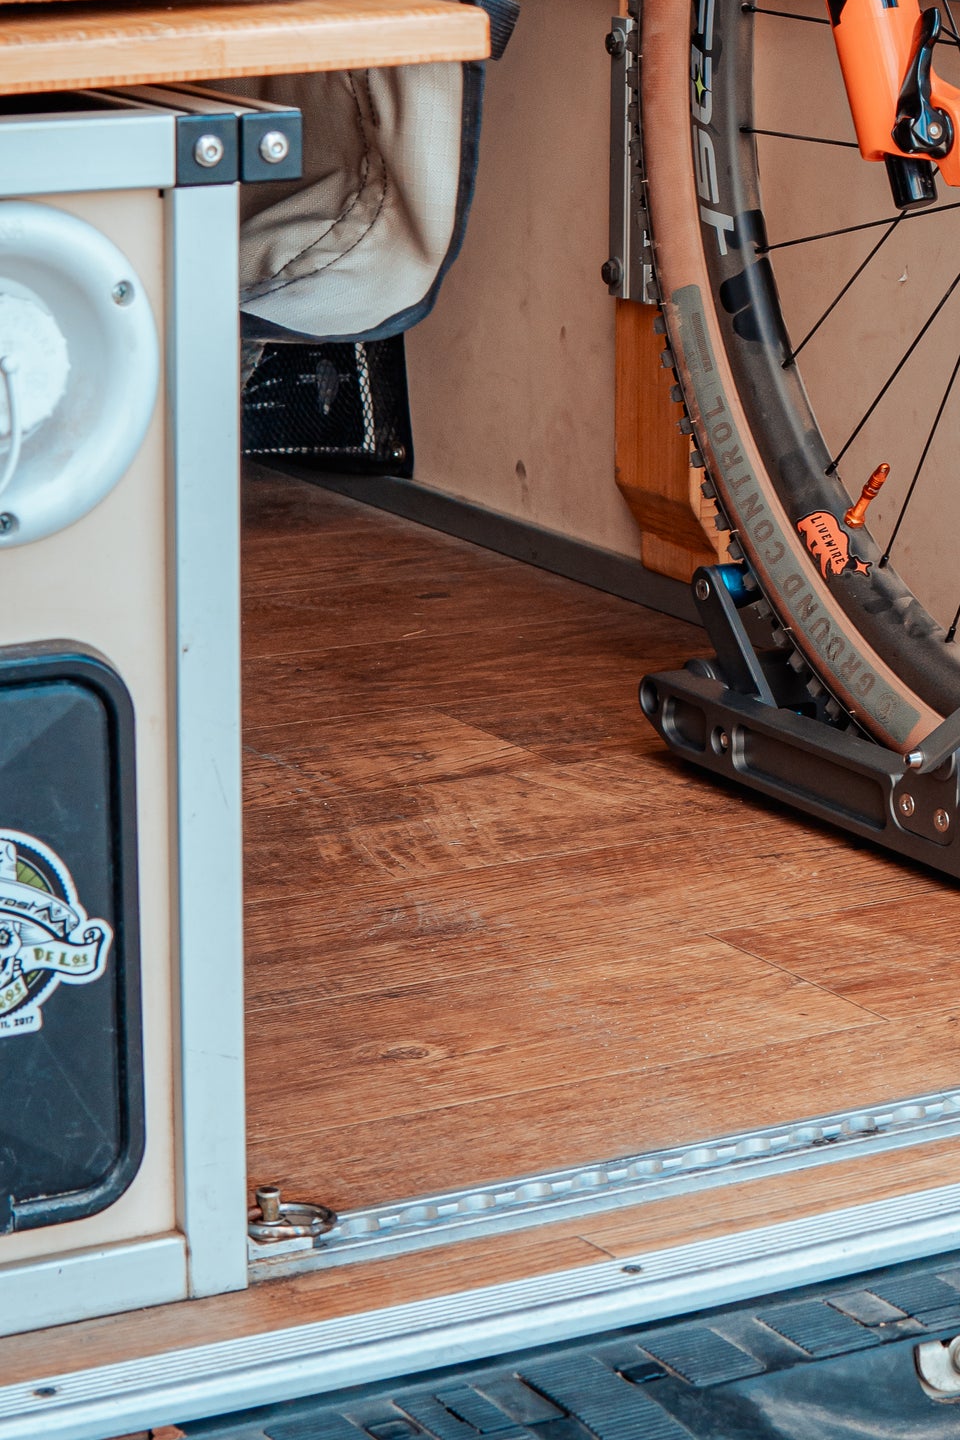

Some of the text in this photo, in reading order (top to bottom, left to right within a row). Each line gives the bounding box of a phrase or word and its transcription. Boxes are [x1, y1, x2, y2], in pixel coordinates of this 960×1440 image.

[704, 394, 875, 695] GROUND CONTROL
[810, 514, 847, 566] LIVEWIRE
[13, 1015, 35, 1027] 2017
